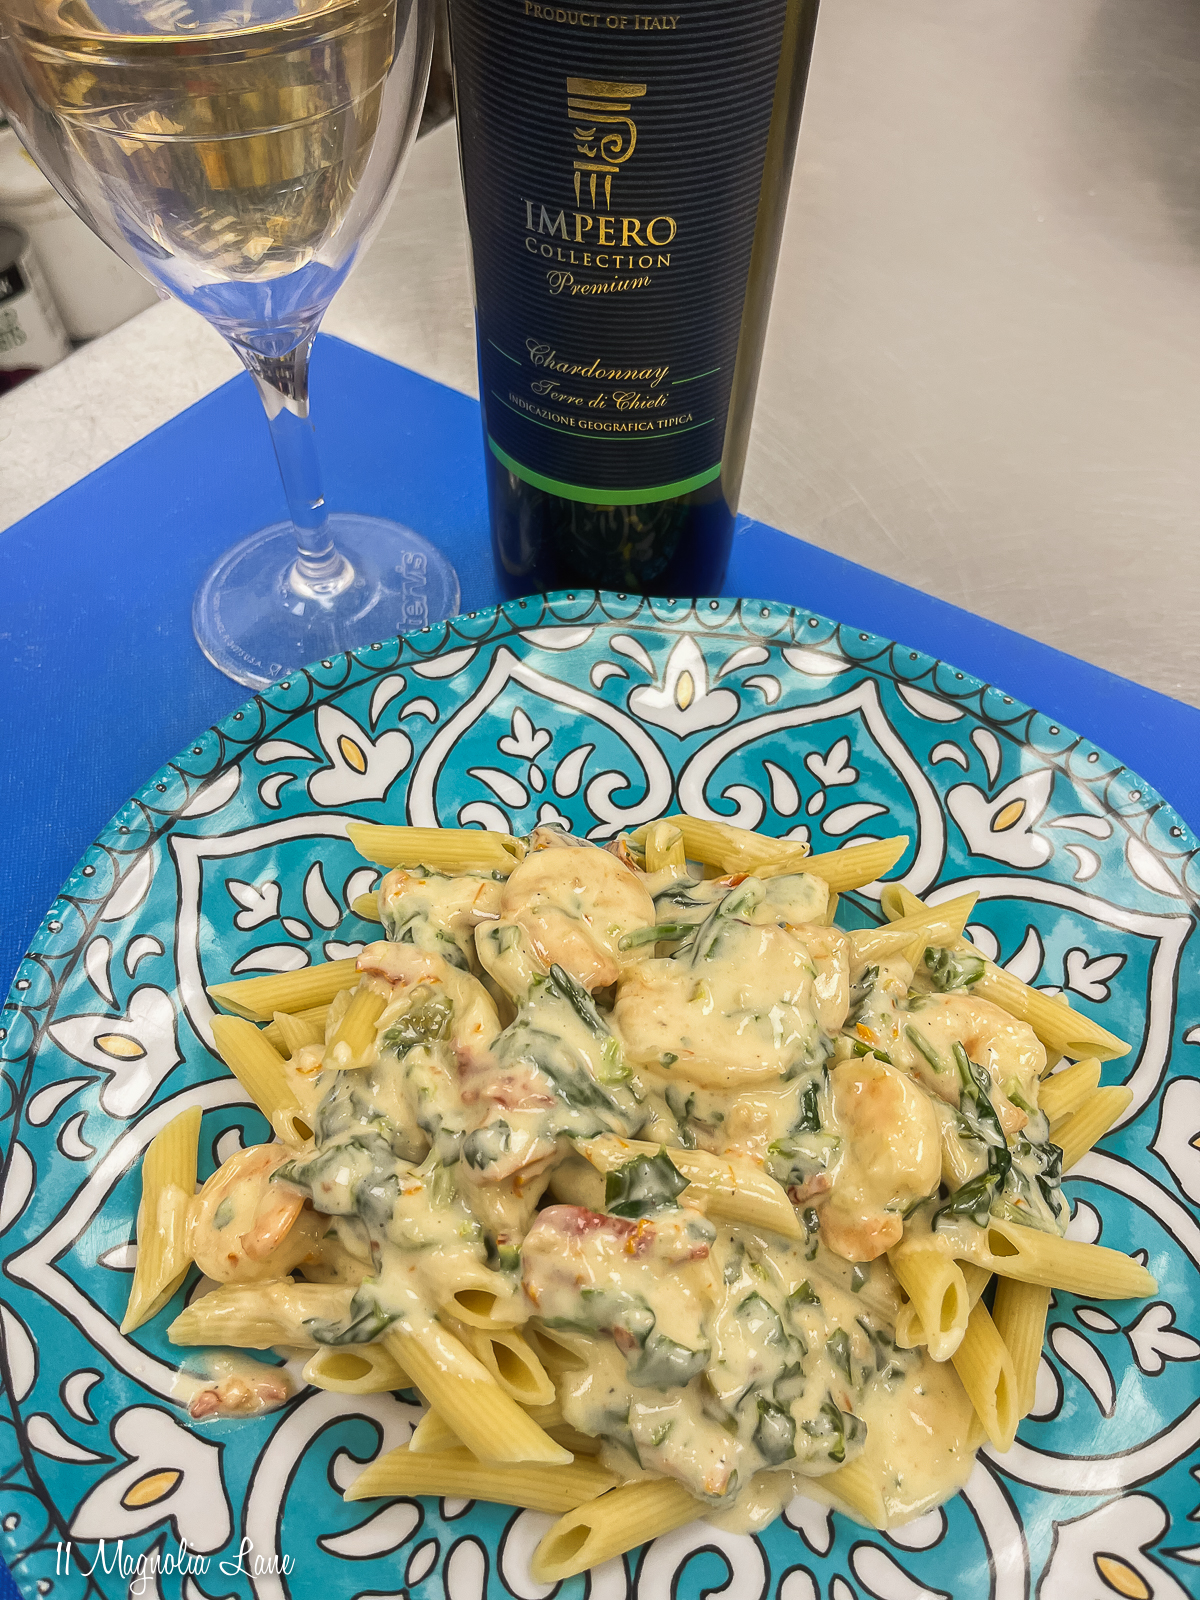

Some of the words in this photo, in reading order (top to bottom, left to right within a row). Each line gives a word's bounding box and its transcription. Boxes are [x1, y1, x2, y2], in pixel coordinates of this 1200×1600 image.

[524, 0, 600, 29] PRODUCT
[606, 15, 628, 29] OF
[634, 15, 680, 30] ITALY
[524, 199, 677, 247] IMPERO
[525, 237, 672, 269] COLLECTION
[547, 270, 652, 296] Premium
[525, 338, 669, 388] Chardonnay
[508, 392, 576, 428] INDICAZIONE
[578, 419, 654, 432] GEOGRAFICA
[657, 413, 693, 429] TIPICA
[531, 380, 584, 406] Terre
[588, 393, 608, 409] di
[612, 391, 669, 412] Chieti
